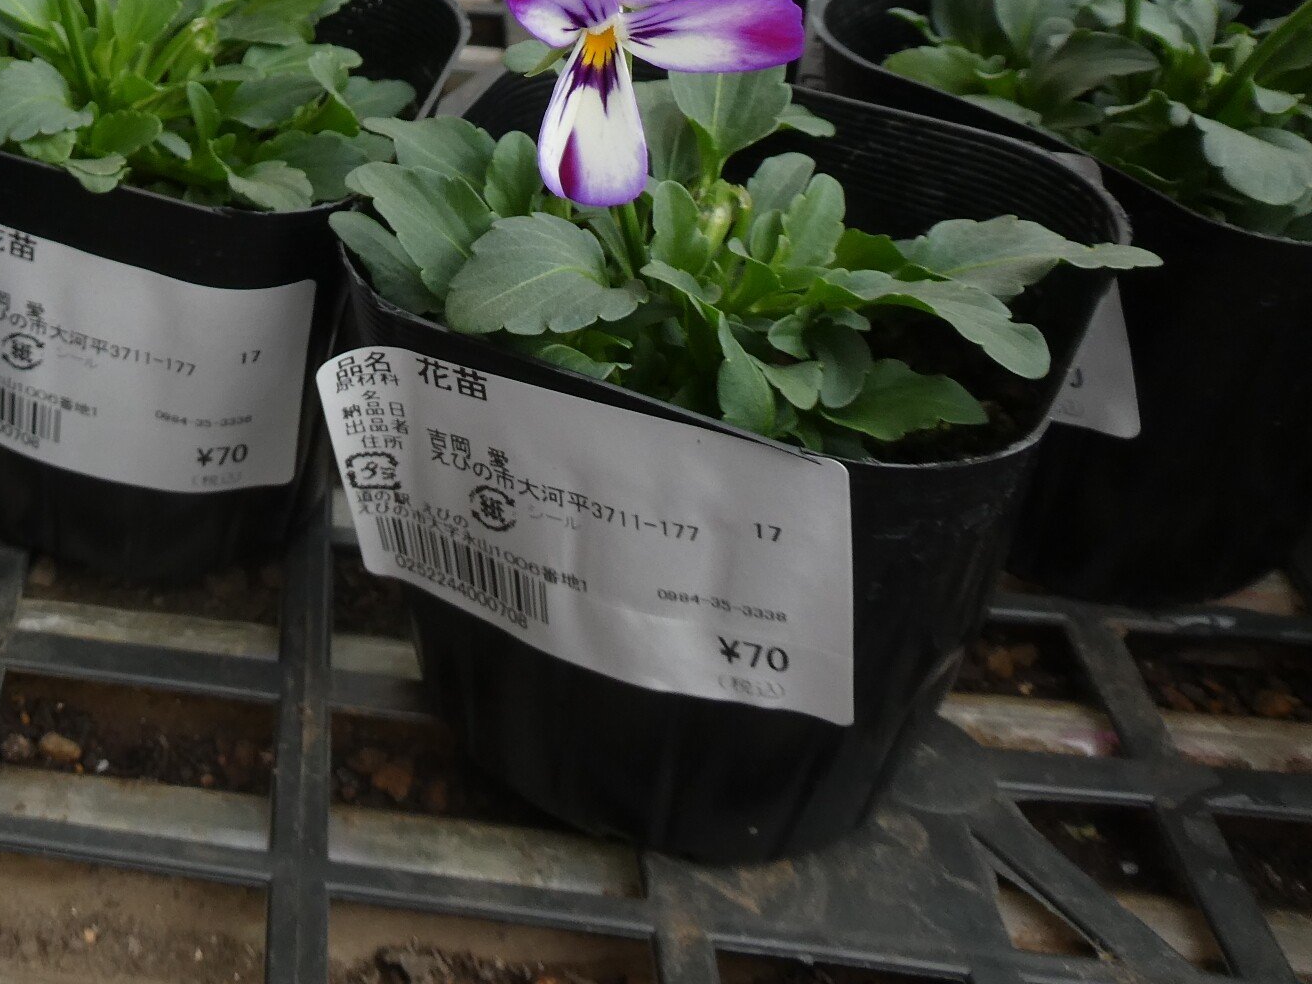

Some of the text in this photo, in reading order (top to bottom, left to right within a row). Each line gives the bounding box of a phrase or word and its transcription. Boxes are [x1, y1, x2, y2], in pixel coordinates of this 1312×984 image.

[242, 349, 261, 364] 17
[336, 351, 487, 401] 品名 花苗
[346, 418, 408, 436] 出品者
[361, 434, 403, 450] 住所
[196, 443, 249, 467] ¥70
[754, 523, 782, 542] 17
[718, 635, 789, 672] ¥70
